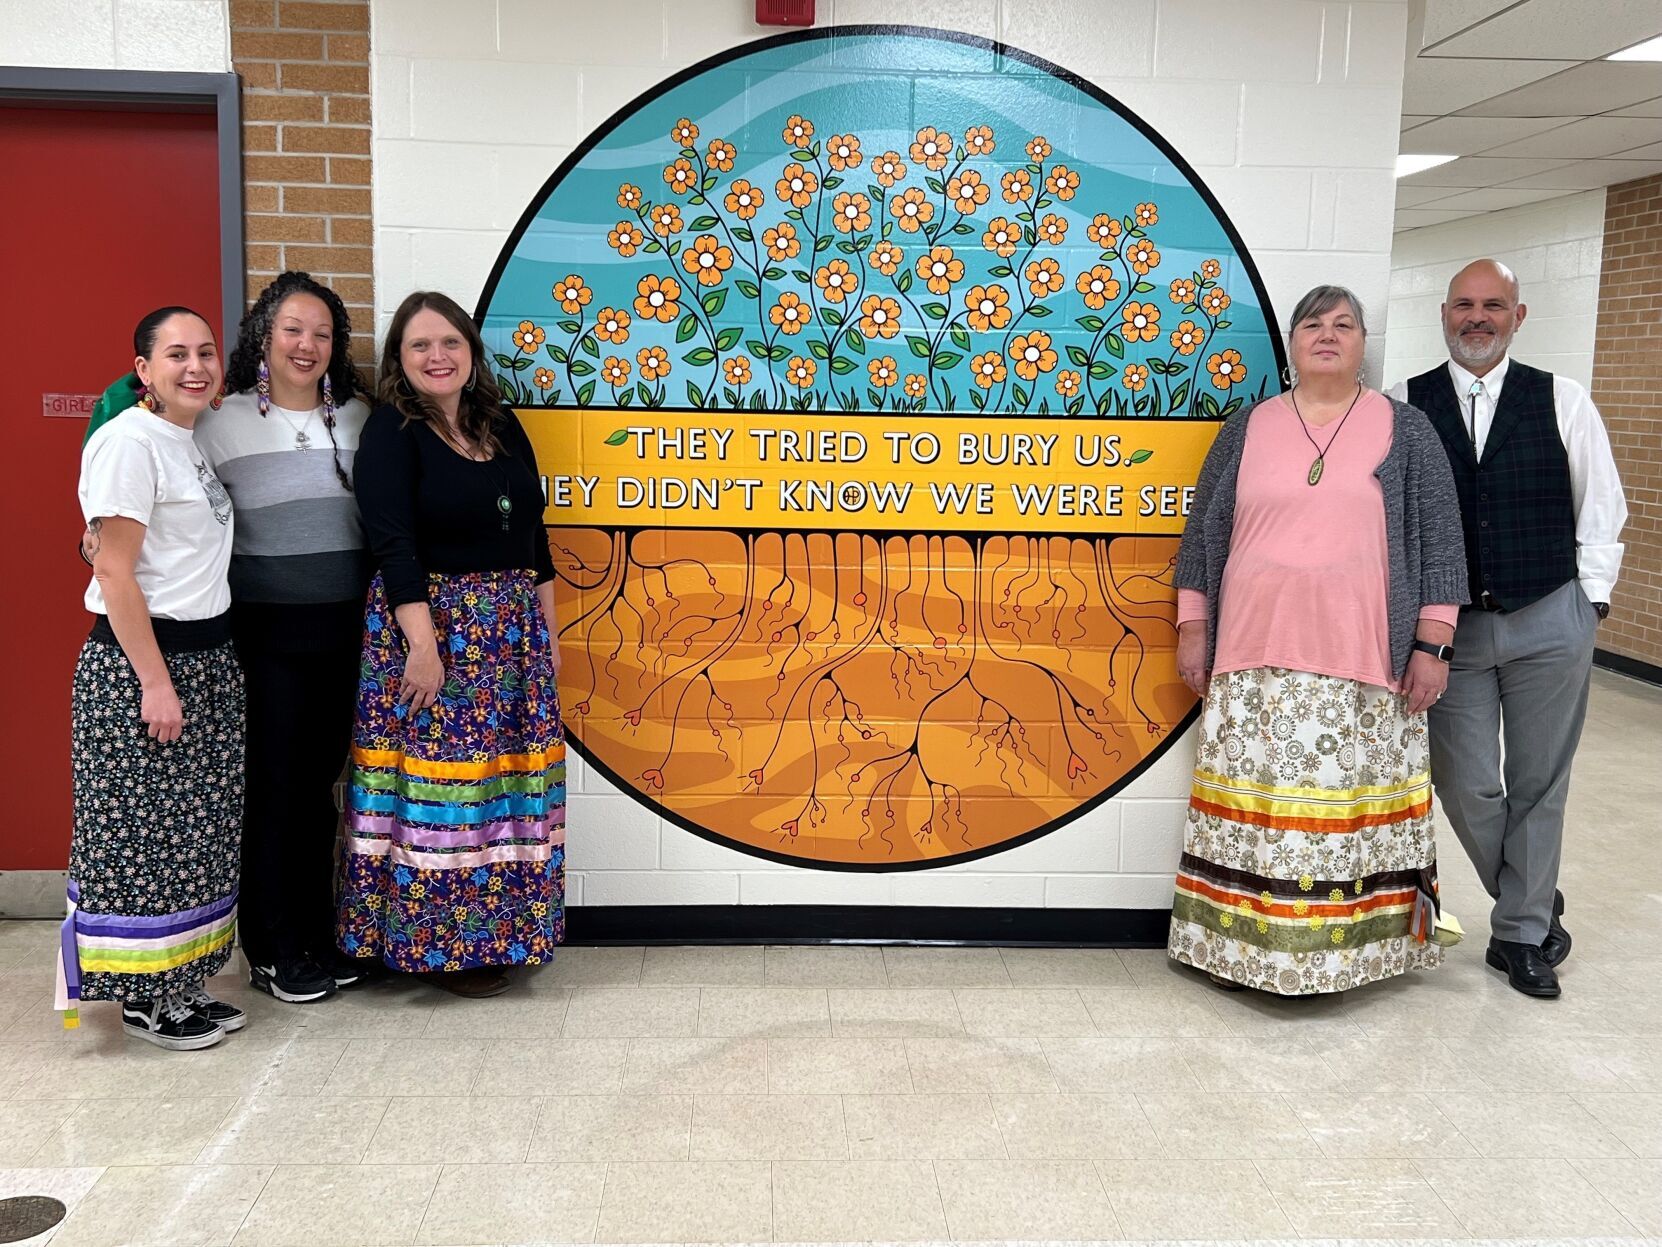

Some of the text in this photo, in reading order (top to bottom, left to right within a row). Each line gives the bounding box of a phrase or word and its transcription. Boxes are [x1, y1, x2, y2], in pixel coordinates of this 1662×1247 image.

[627, 427, 1132, 467] THEY TRIED TO BURY US.
[541, 475, 600, 507] EY
[616, 477, 763, 511] DIDN'T
[778, 480, 912, 513] KNOW
[928, 483, 994, 514] WE
[1010, 485, 1123, 517] WERE
